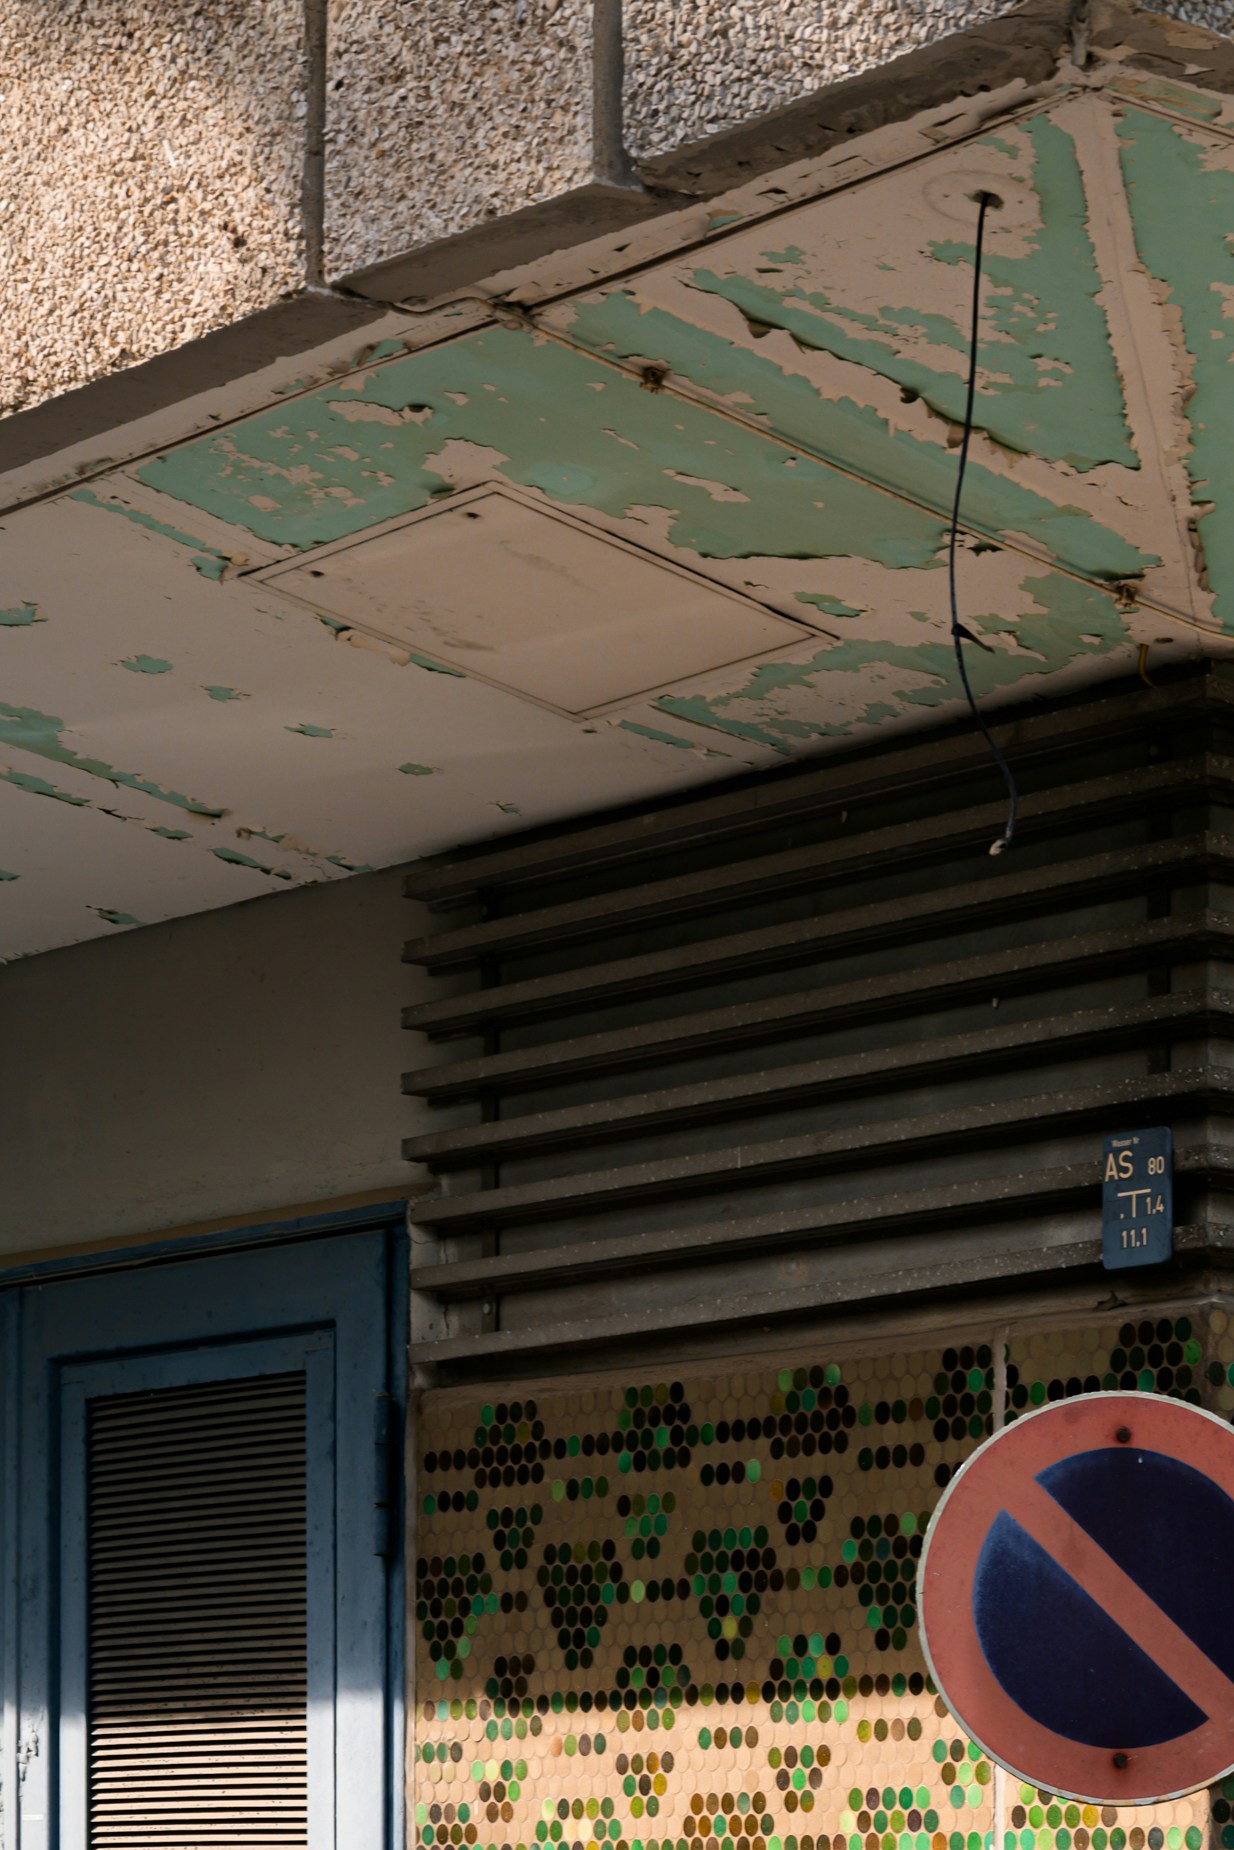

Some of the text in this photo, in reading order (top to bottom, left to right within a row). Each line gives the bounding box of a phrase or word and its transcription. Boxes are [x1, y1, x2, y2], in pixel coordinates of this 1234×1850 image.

[1105, 1151, 1165, 1182] AS 80
[1146, 1195, 1165, 1215] 1,4
[1121, 1227, 1148, 1249] 11,1
